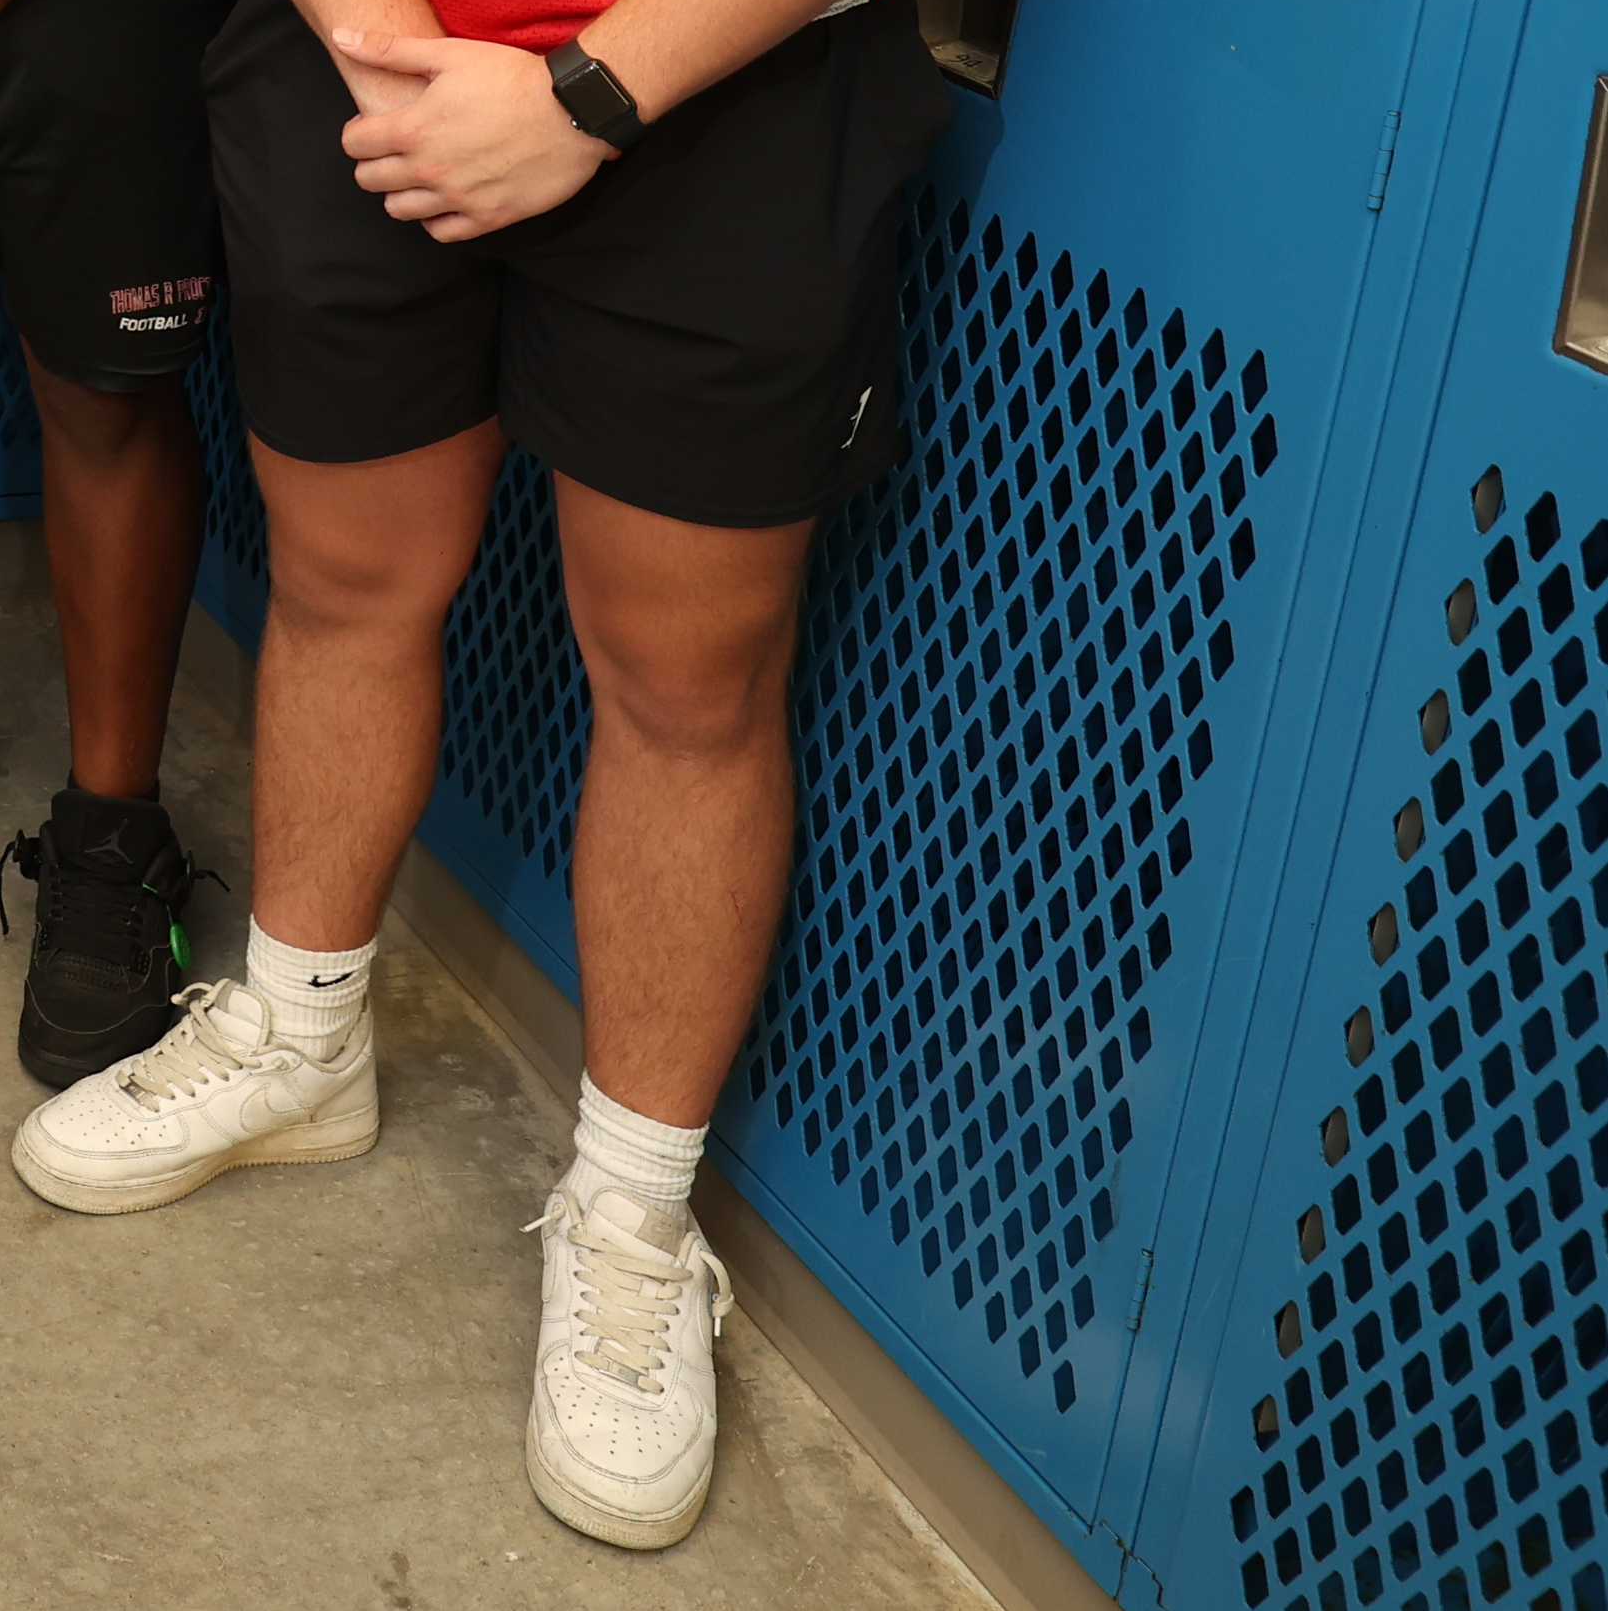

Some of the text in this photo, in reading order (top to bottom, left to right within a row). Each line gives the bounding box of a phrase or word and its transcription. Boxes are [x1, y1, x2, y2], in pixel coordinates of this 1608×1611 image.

[109, 283, 160, 315] THOMAS
[163, 281, 174, 305] R
[119, 314, 188, 332] FOOTBALL
